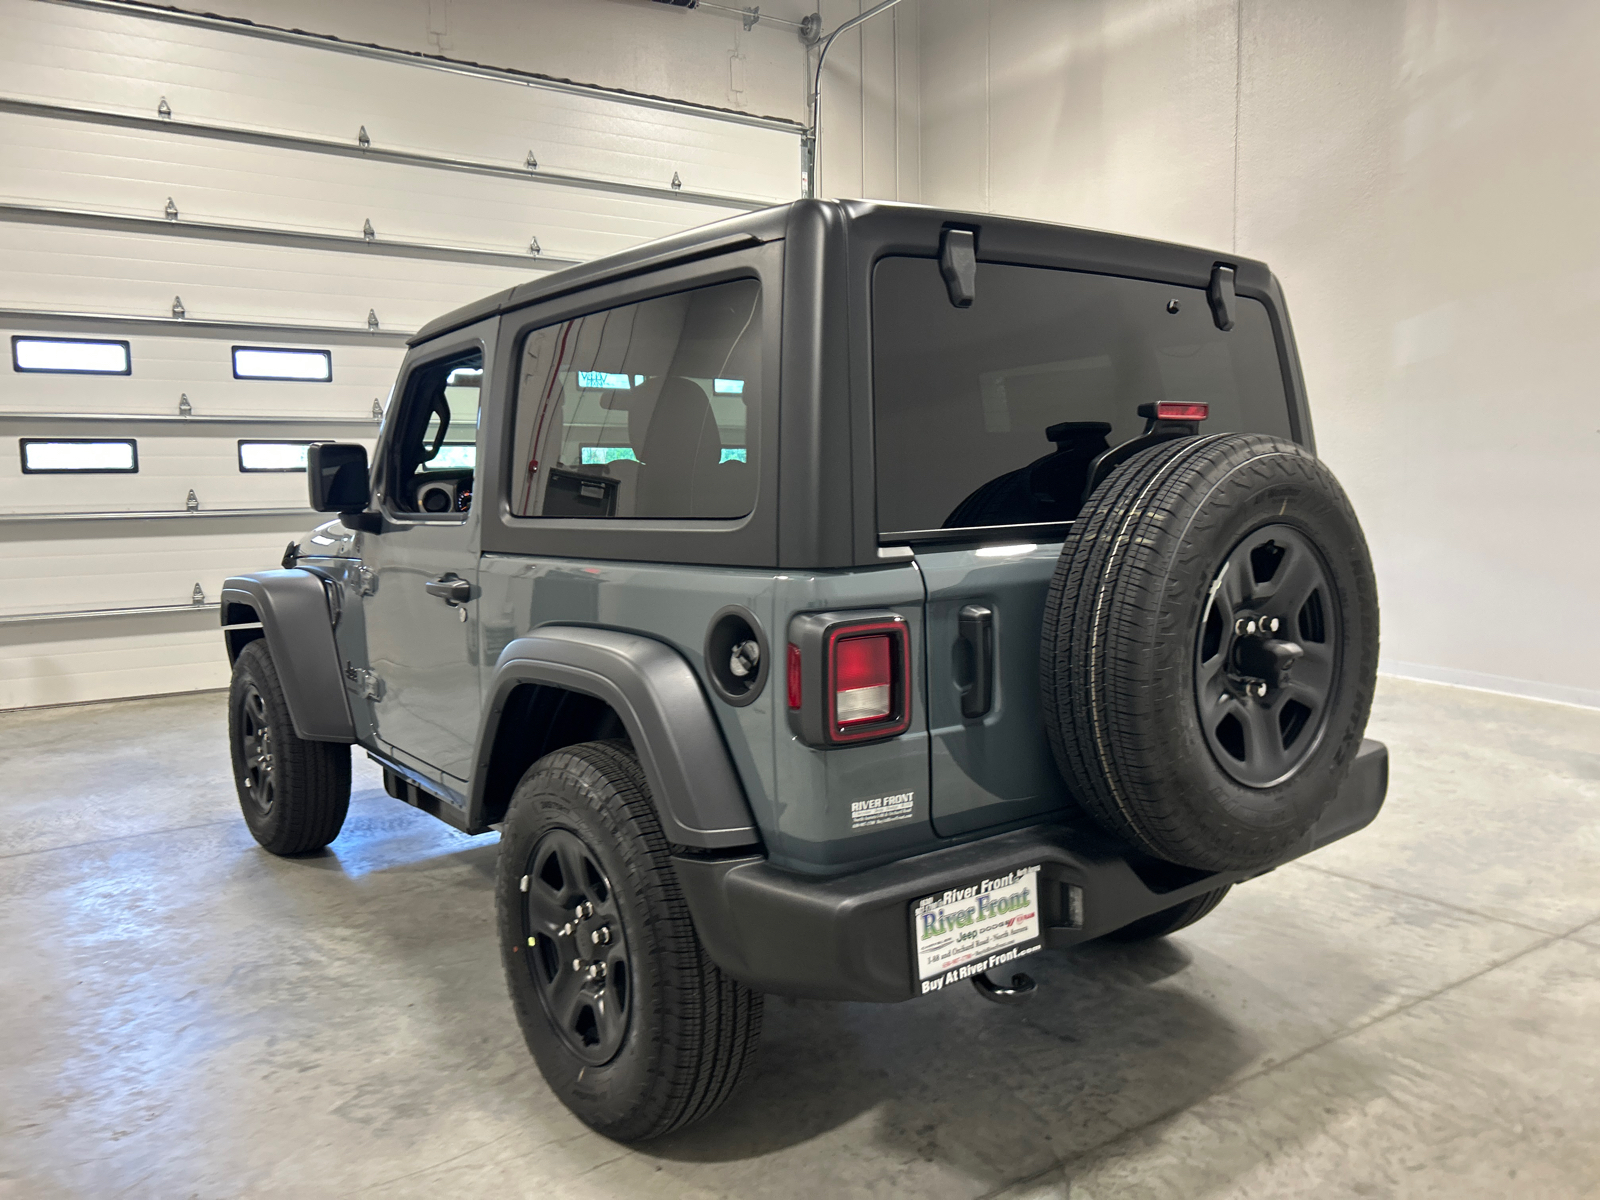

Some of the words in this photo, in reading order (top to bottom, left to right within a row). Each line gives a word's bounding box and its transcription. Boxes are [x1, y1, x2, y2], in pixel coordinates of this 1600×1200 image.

[851, 798, 881, 811] RIVER
[883, 791, 914, 806] FRONT
[943, 885, 978, 905] River
[980, 872, 1013, 894] Front
[921, 906, 976, 941] River
[975, 887, 1030, 923] Front
[956, 929, 978, 943] Jeep
[921, 974, 944, 994] Buy
[945, 971, 960, 985] At
[959, 960, 988, 980] River
